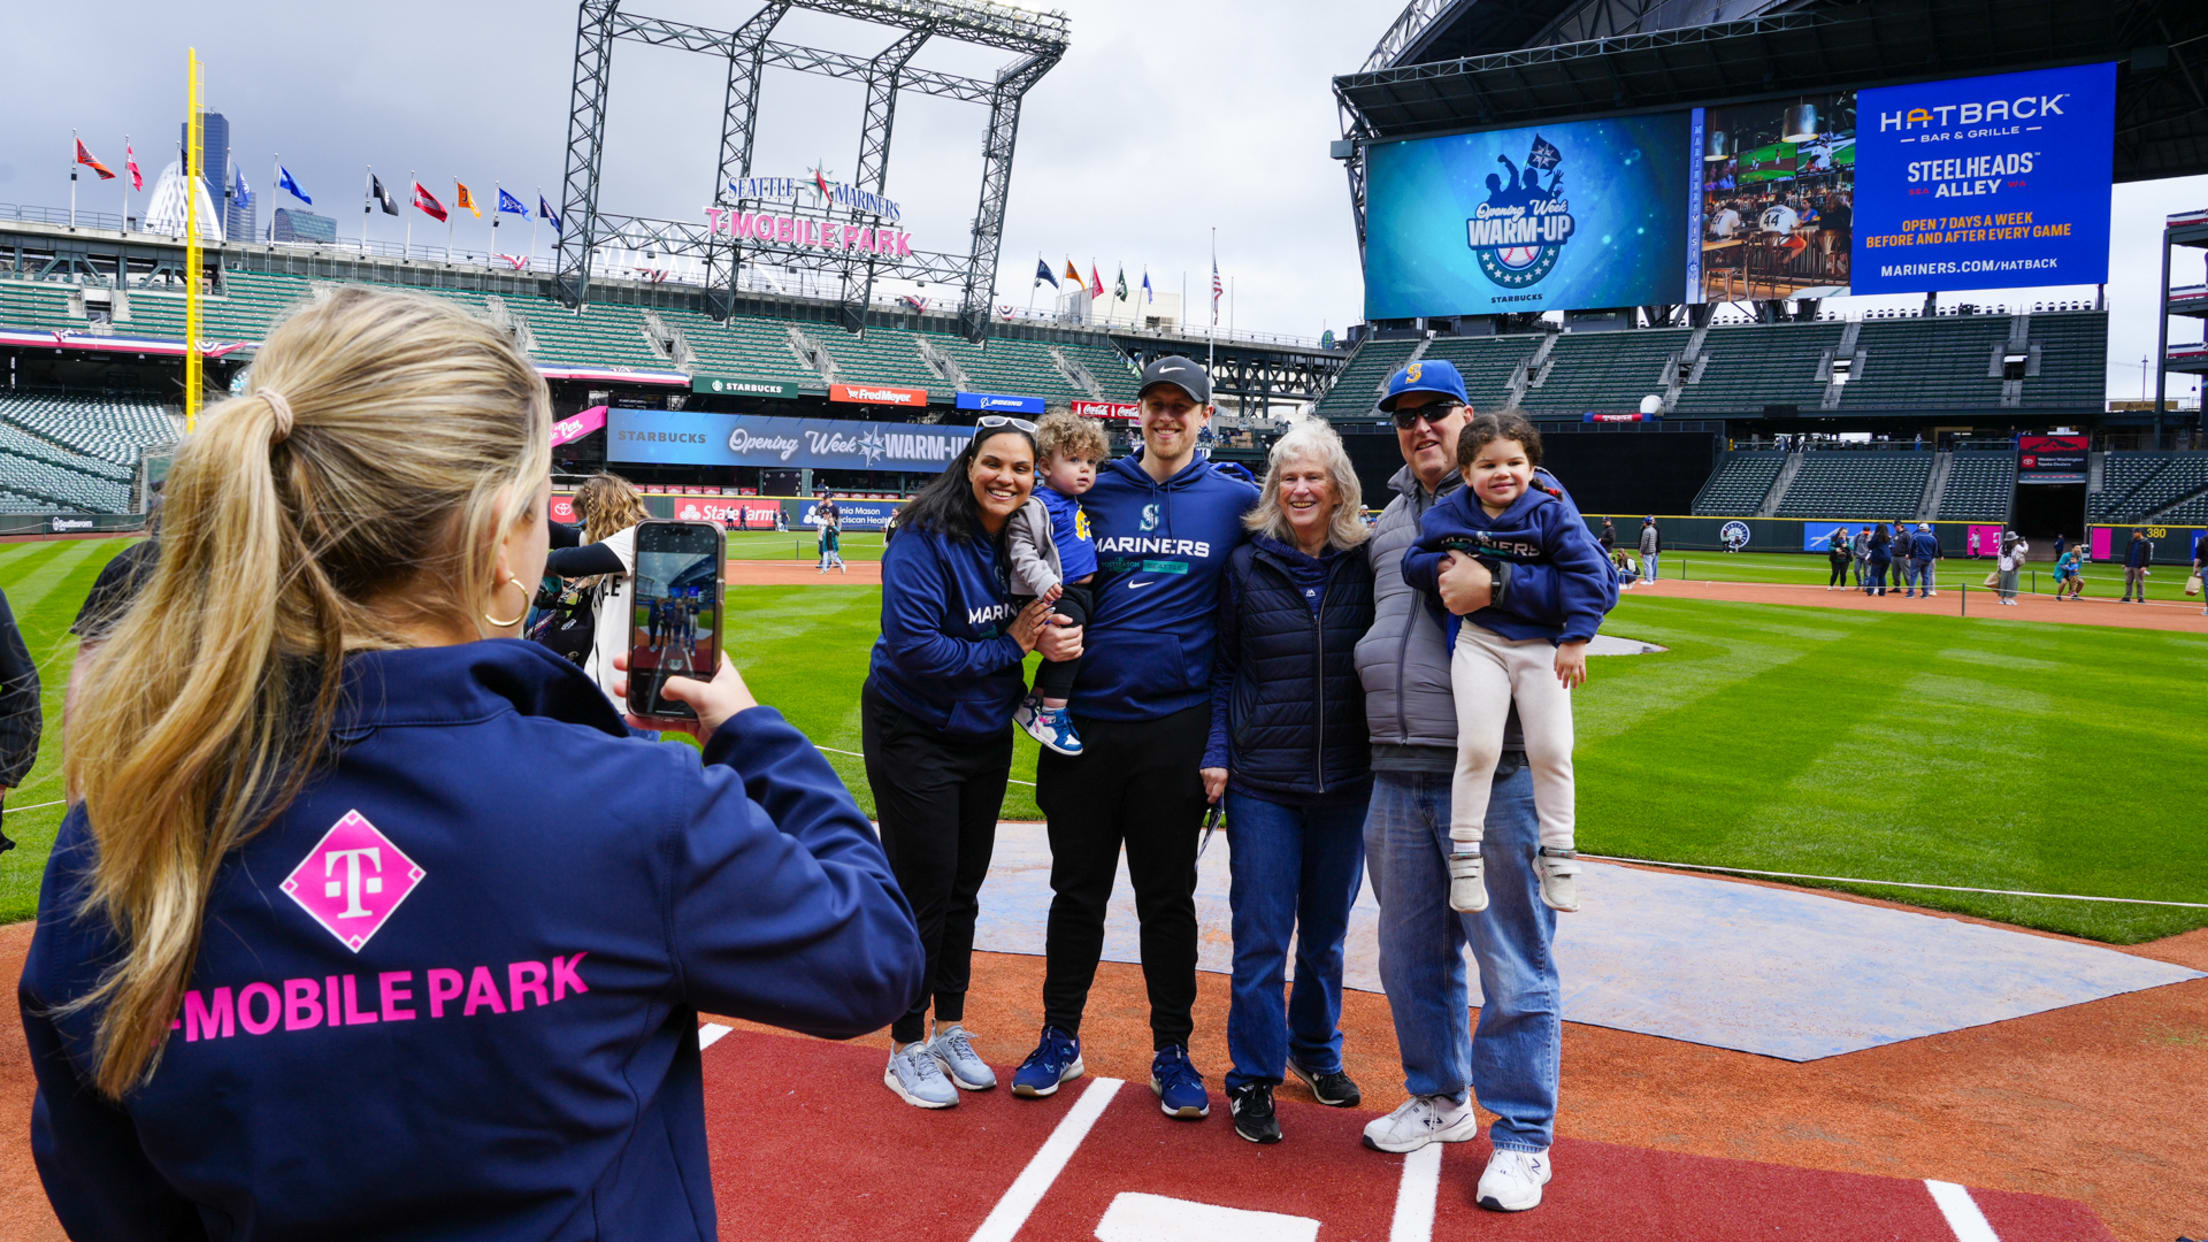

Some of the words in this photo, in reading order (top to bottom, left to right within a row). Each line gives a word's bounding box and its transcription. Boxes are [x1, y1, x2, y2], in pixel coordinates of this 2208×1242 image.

[1880, 94, 2064, 132] HATBACK
[1920, 132, 1950, 143] BAR
[1954, 131, 1963, 140] &
[1967, 126, 2020, 139] GRILLE
[1907, 152, 2033, 182] STEELHEADS
[1935, 178, 2002, 198] ALLEY
[727, 176, 795, 200] SEATTLE
[836, 181, 900, 222] MARINERS
[1476, 203, 1526, 222] Opening
[1529, 199, 1568, 216] Week
[704, 207, 836, 249] T-MOBILE
[843, 224, 913, 257] PARK
[1468, 215, 1571, 246] WARM-UP
[1902, 217, 1937, 232] OPEN
[1939, 217, 1947, 229] 7
[1949, 215, 1981, 228] DAYS
[1983, 214, 1992, 226] A
[1995, 211, 2033, 225] WEEK
[1866, 233, 1914, 248] BEFORE
[1916, 231, 1943, 245] AND
[1945, 228, 1986, 243] AFTER
[1988, 227, 2030, 241] EVERY
[2033, 223, 2072, 238] GAME
[1881, 258, 2058, 277] MARINERS.COM/HATBACK
[1491, 293, 1543, 303] STARBUCKS
[726, 383, 783, 393] STARBUCKS
[618, 430, 706, 444] STARBUCKS
[729, 428, 799, 460] Opening
[805, 431, 857, 455] Week
[744, 505, 774, 521] arm
[854, 507, 880, 515] Mason
[2146, 527, 2167, 538] 380
[166, 970, 416, 1044] -MOBILE
[427, 951, 589, 1018] PARK
